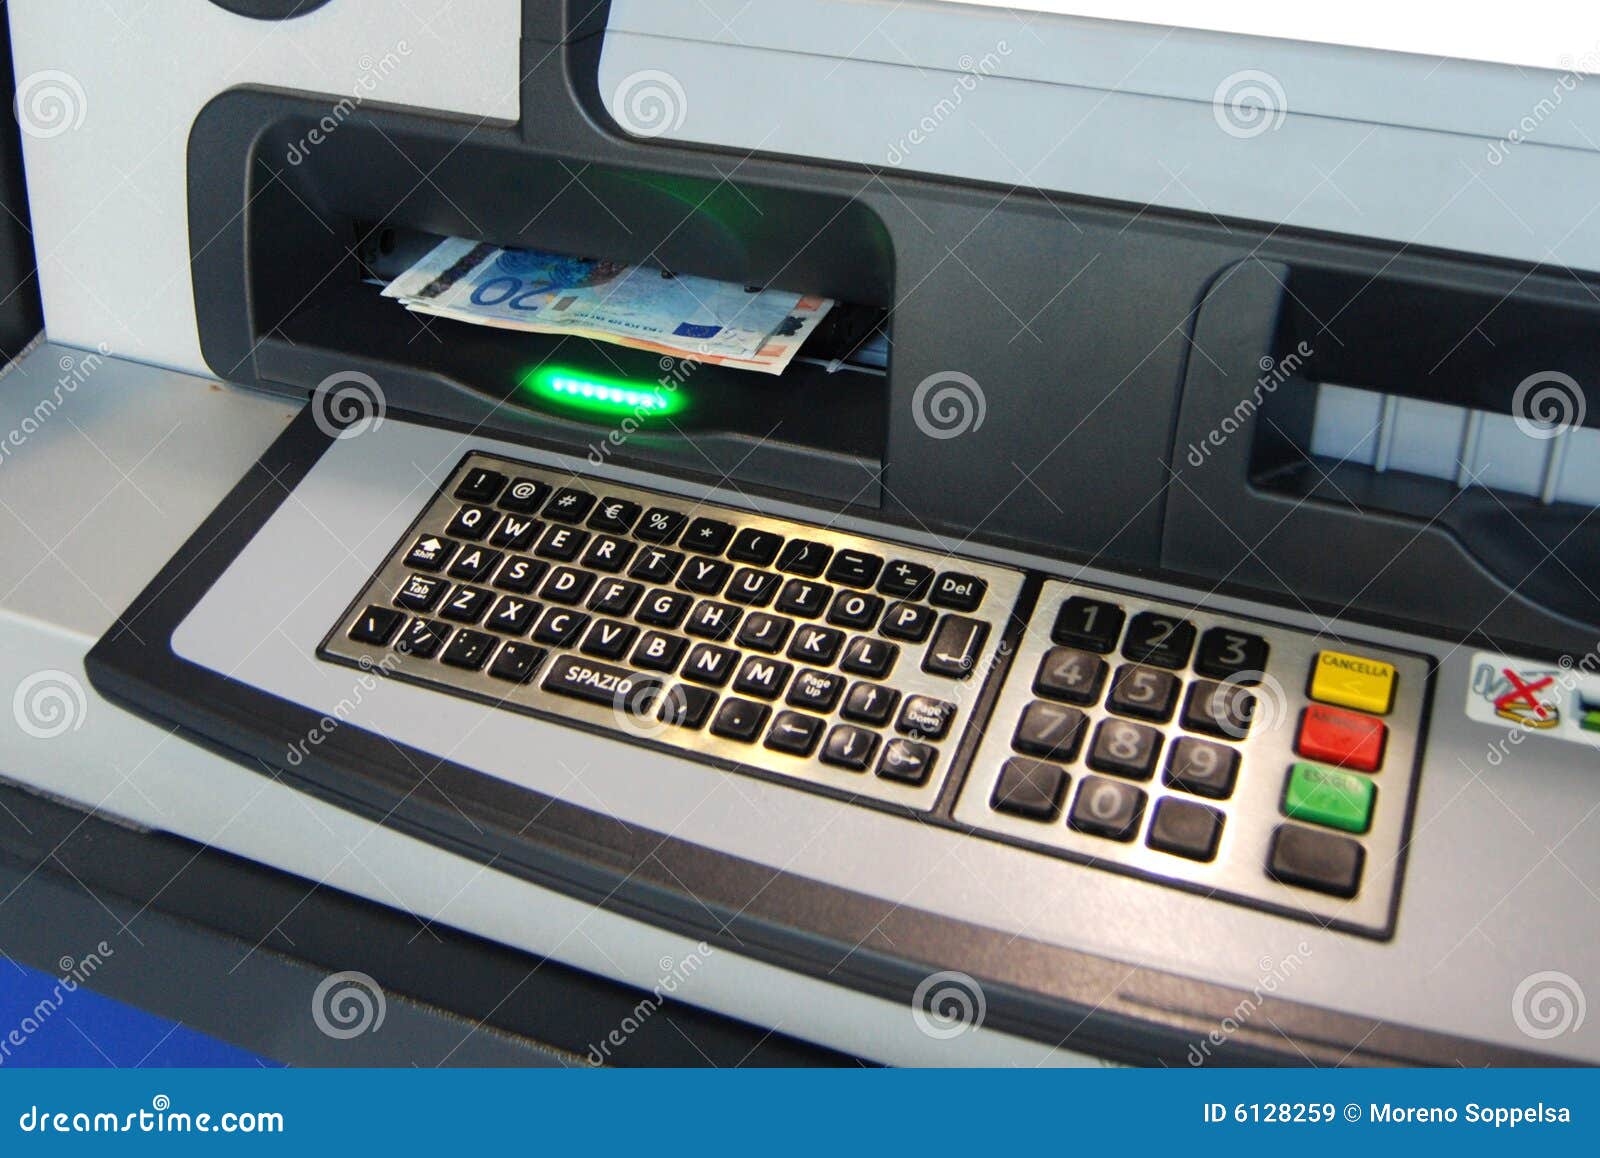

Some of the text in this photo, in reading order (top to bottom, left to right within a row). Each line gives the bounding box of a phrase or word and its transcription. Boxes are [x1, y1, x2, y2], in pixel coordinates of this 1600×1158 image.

[470, 275, 552, 311] 20
[413, 549, 435, 560] Shift
[462, 510, 918, 627] Q W E R T Y U I O P
[410, 582, 429, 595] Tab
[942, 579, 972, 596] Del
[462, 552, 872, 663] A S D F G H J K L
[453, 591, 771, 684] Z X C V B N M
[1082, 605, 1246, 664] 1 2 3
[565, 666, 632, 694] SPAZIO
[1053, 656, 1082, 684] 4
[1128, 673, 1158, 700] 5
[1321, 654, 1388, 677] CANCELLA
[804, 674, 831, 689] Page
[805, 685, 821, 697] Up
[1036, 711, 1218, 776] 7 8 9
[1091, 787, 1122, 818] 0
